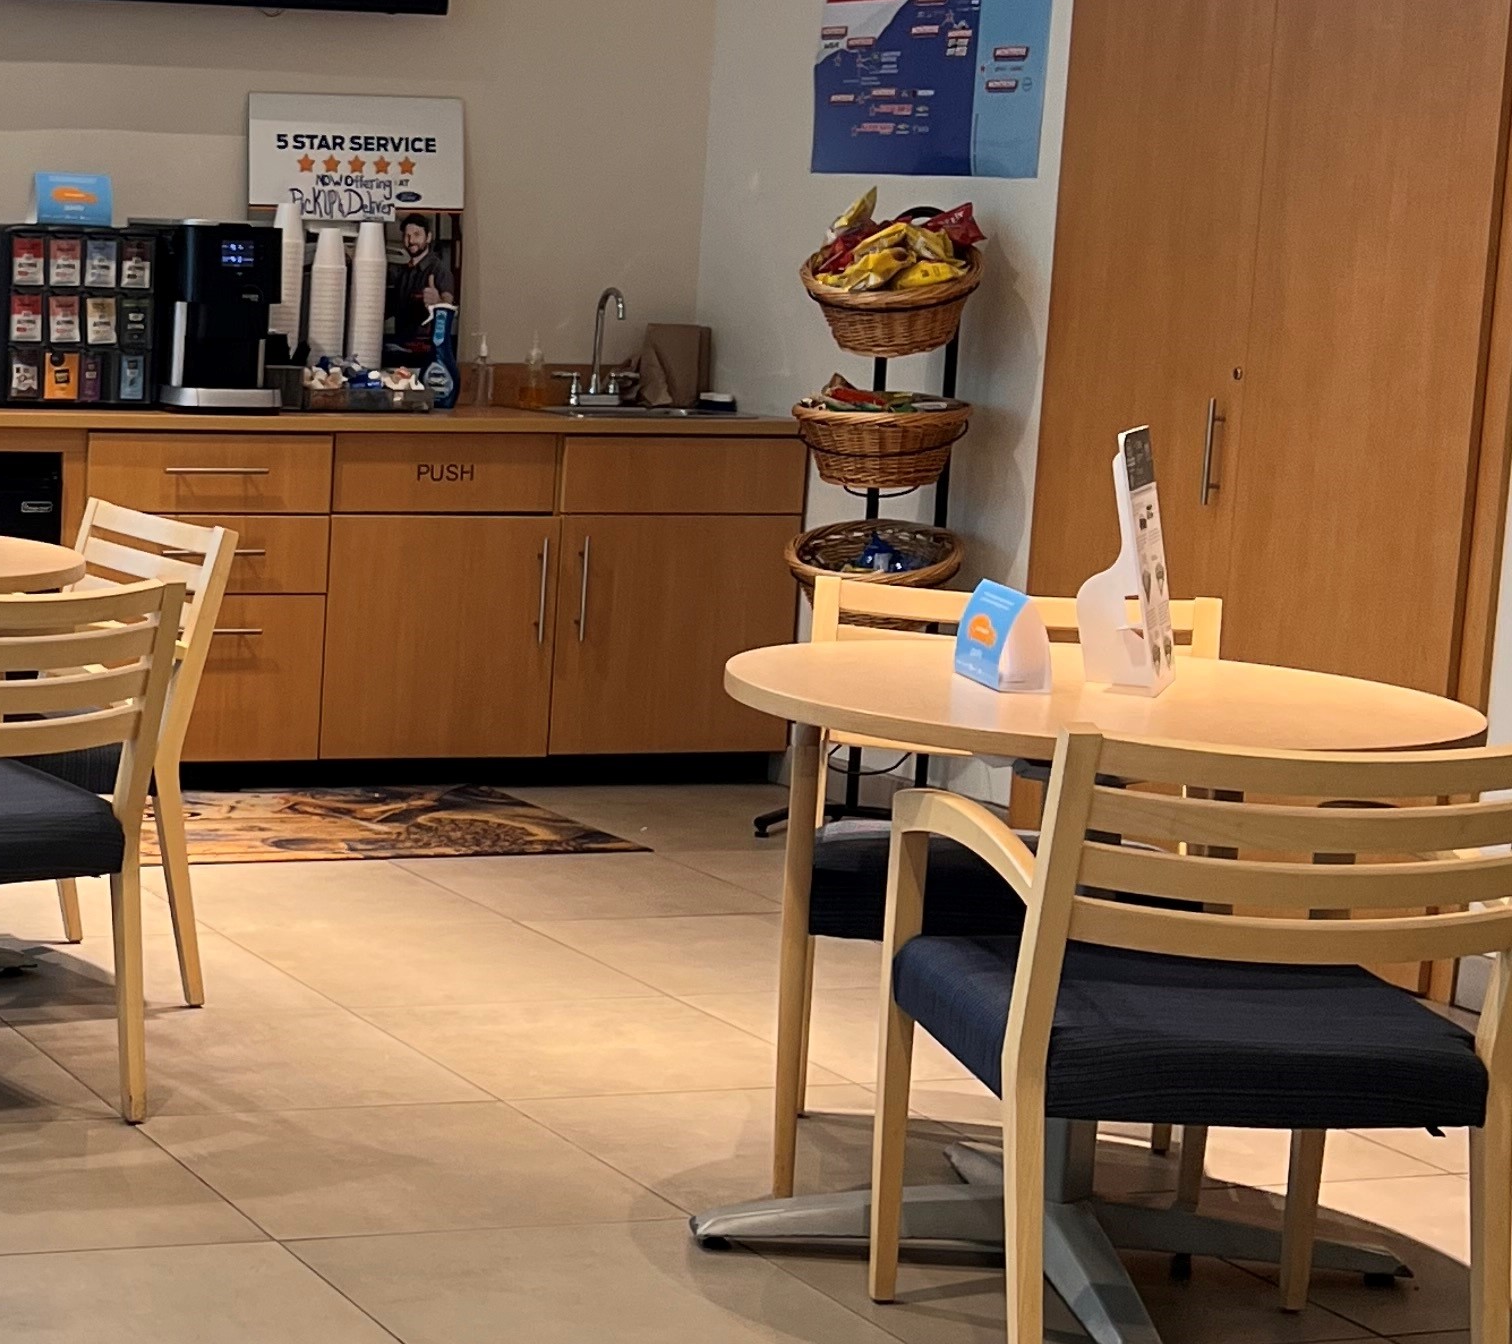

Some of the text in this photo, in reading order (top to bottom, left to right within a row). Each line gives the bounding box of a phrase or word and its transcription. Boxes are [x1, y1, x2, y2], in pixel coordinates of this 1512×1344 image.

[276, 133, 437, 153] 5 STAR SERVICE
[417, 463, 475, 482] PUSH
